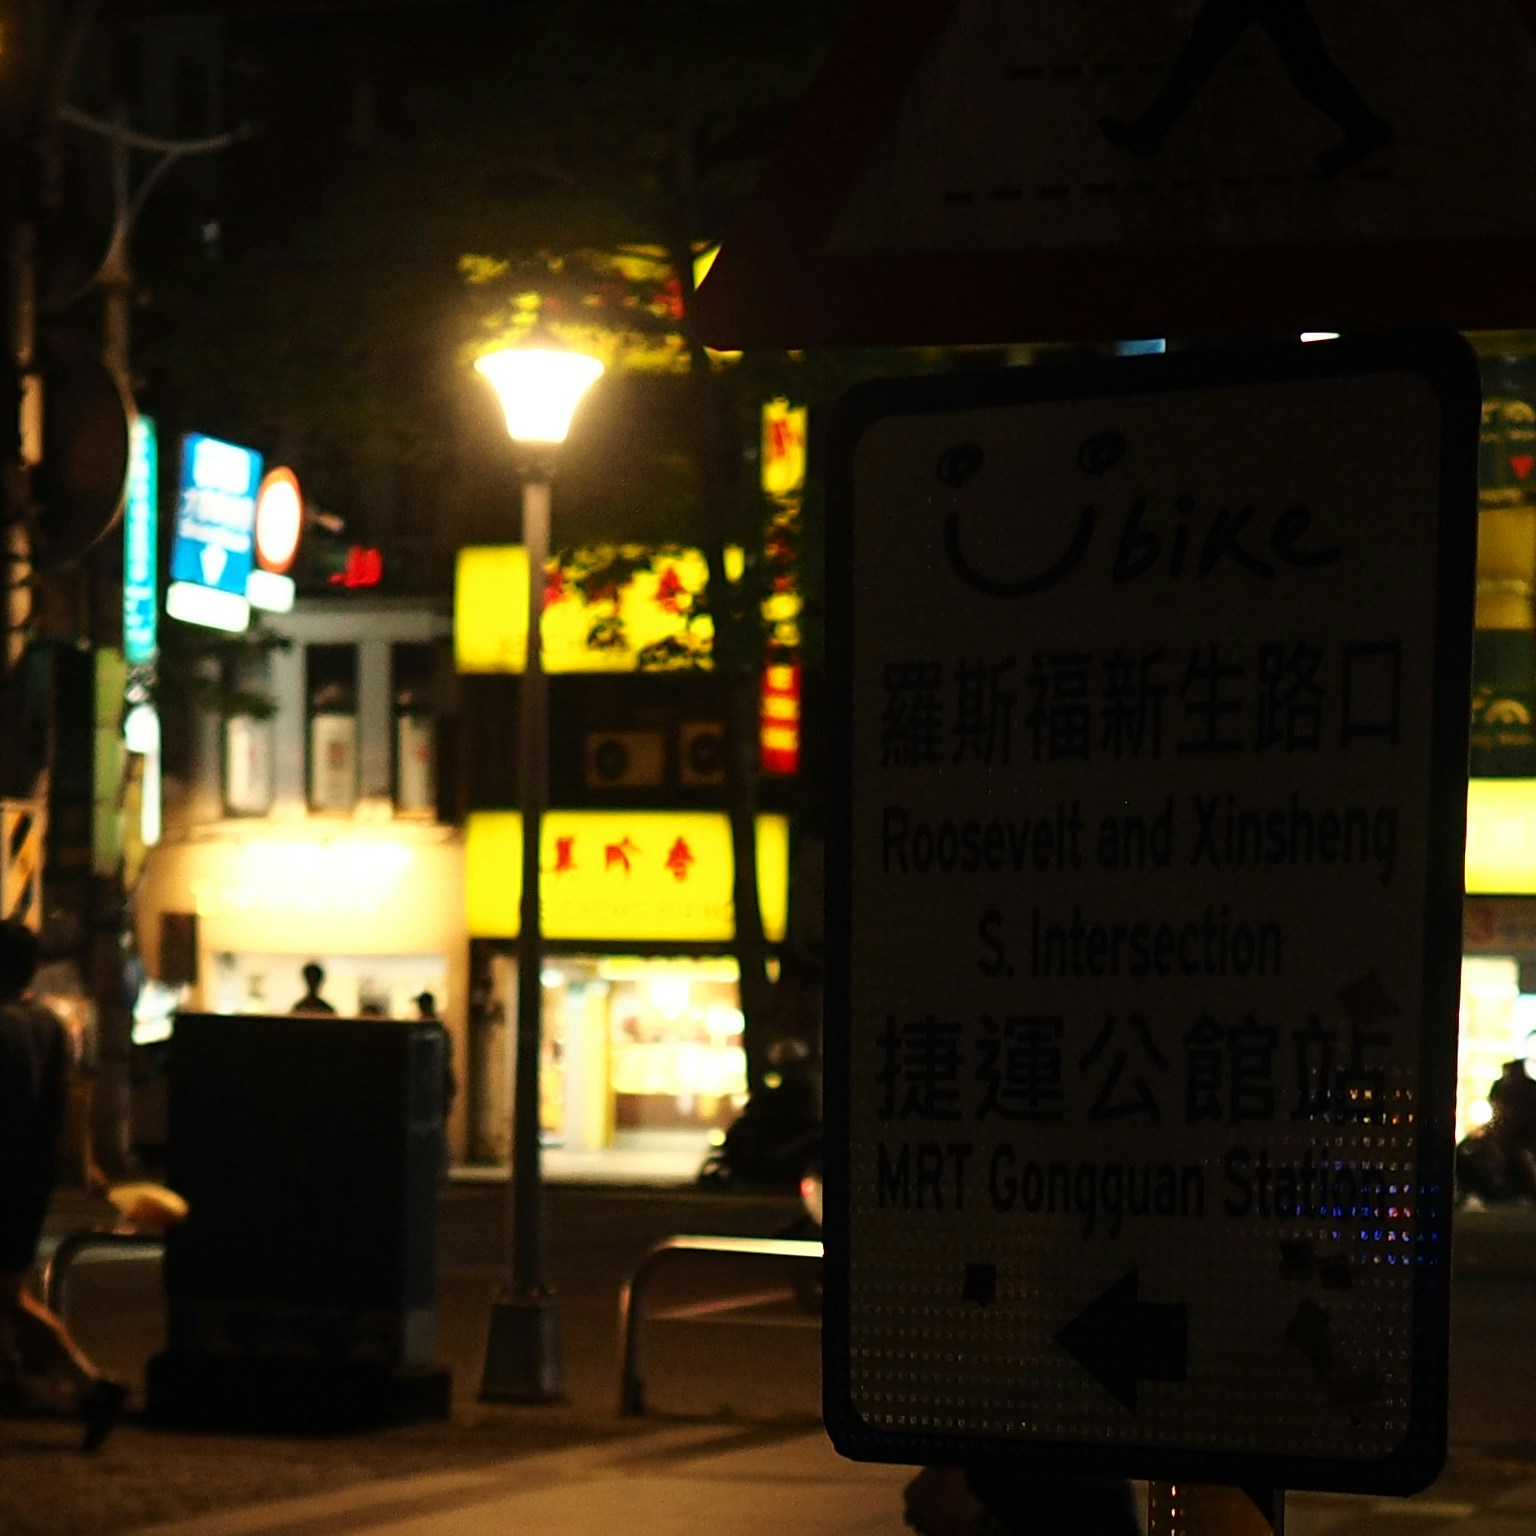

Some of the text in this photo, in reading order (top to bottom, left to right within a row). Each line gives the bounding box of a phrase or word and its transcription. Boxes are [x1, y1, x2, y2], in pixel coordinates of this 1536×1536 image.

[880, 642, 1403, 766] 羅斯福新生路口
[882, 802, 1084, 874] Roosevelt
[1098, 798, 1174, 868] and
[1189, 794, 1398, 886] Xinsheng
[977, 906, 1285, 978] S. Intersection
[876, 1014, 1392, 1125] 捷運公館站
[876, 1142, 1389, 1239] MRT Gongguan Station
